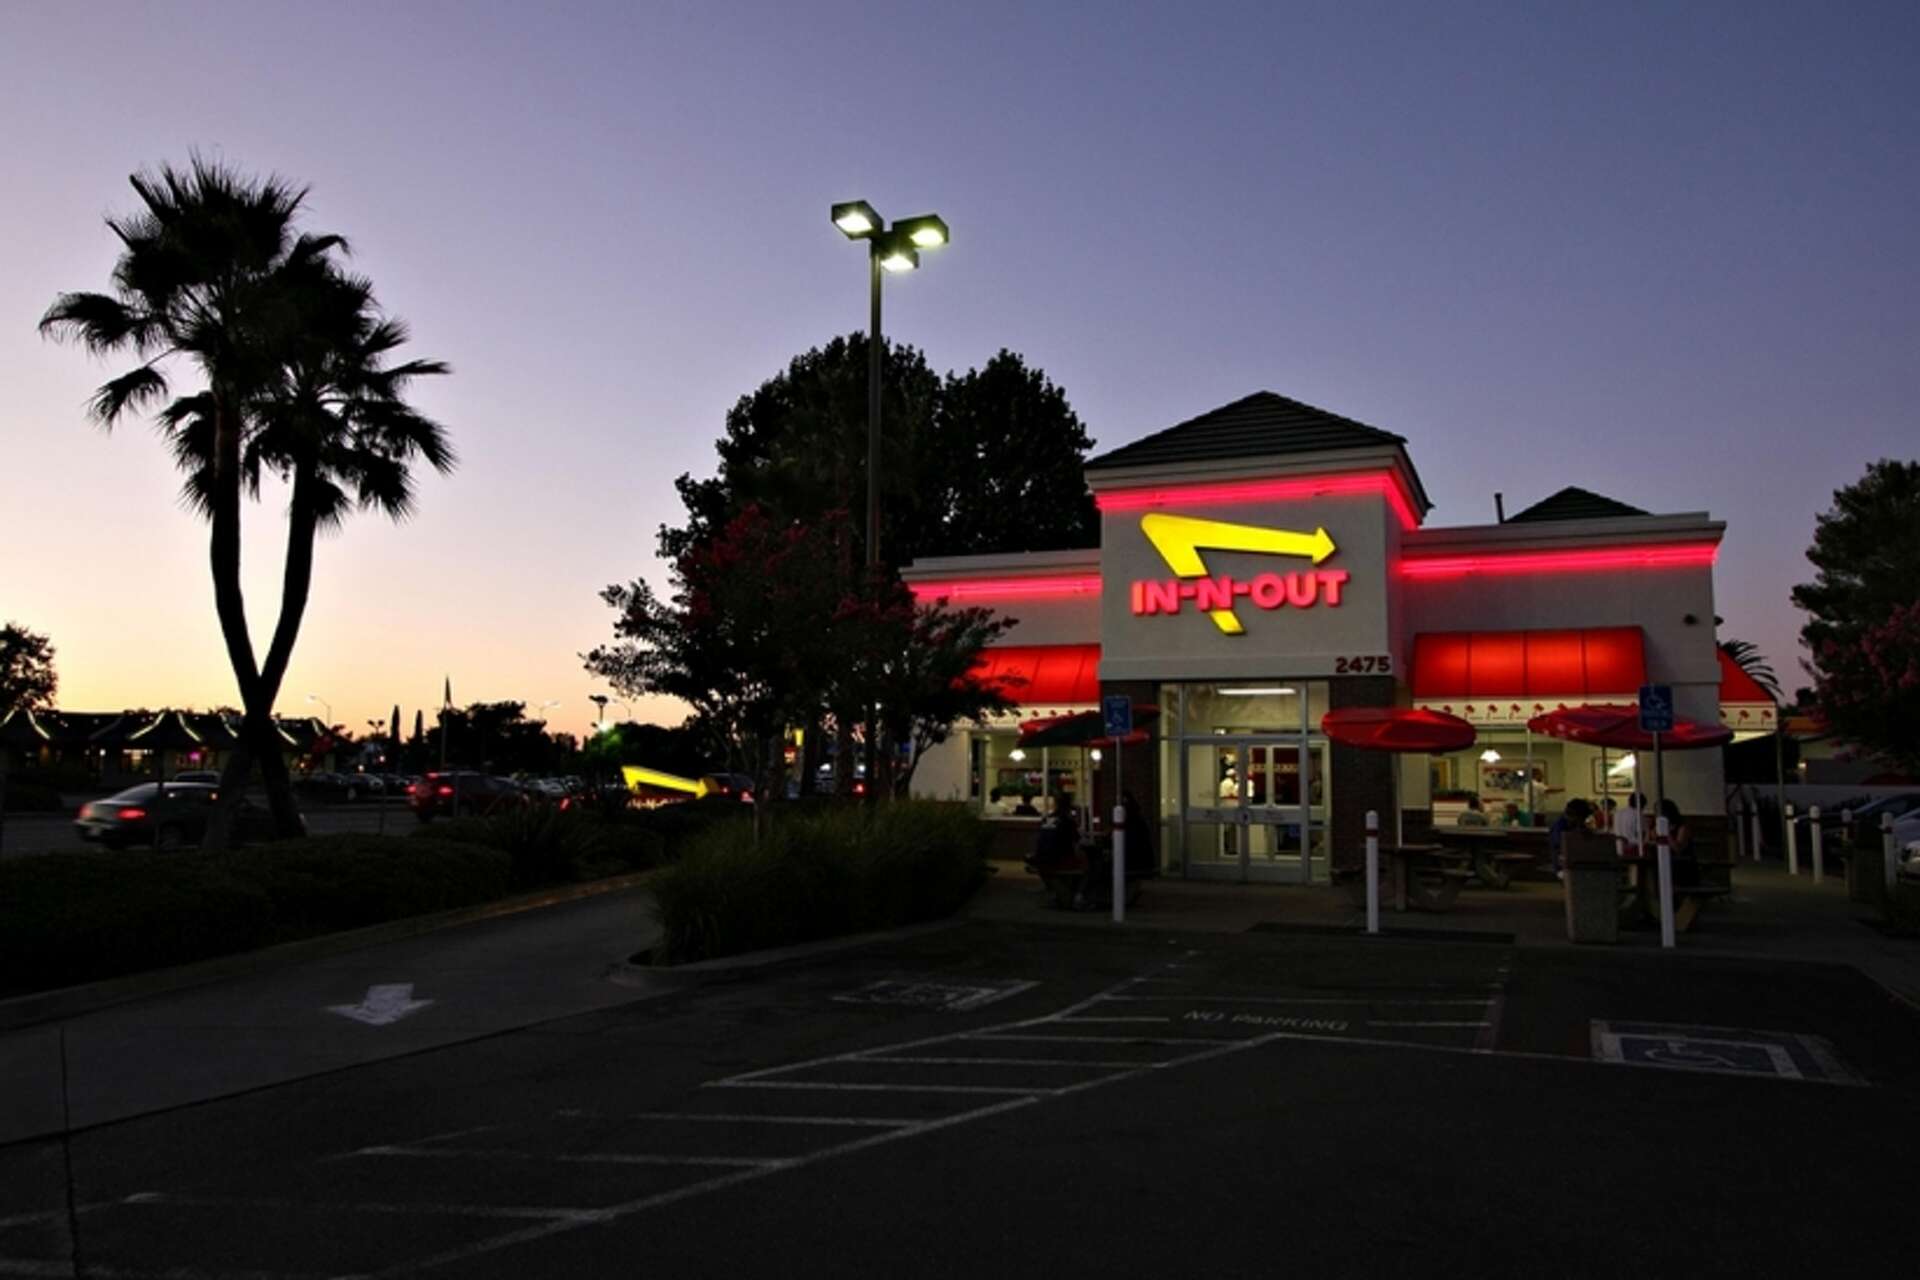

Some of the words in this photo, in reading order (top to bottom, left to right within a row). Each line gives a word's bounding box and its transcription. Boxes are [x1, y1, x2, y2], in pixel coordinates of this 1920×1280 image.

[1131, 569, 1349, 615] IN-N-OUT
[1336, 656, 1390, 673] 2475
[1183, 1009, 1225, 1022] NO
